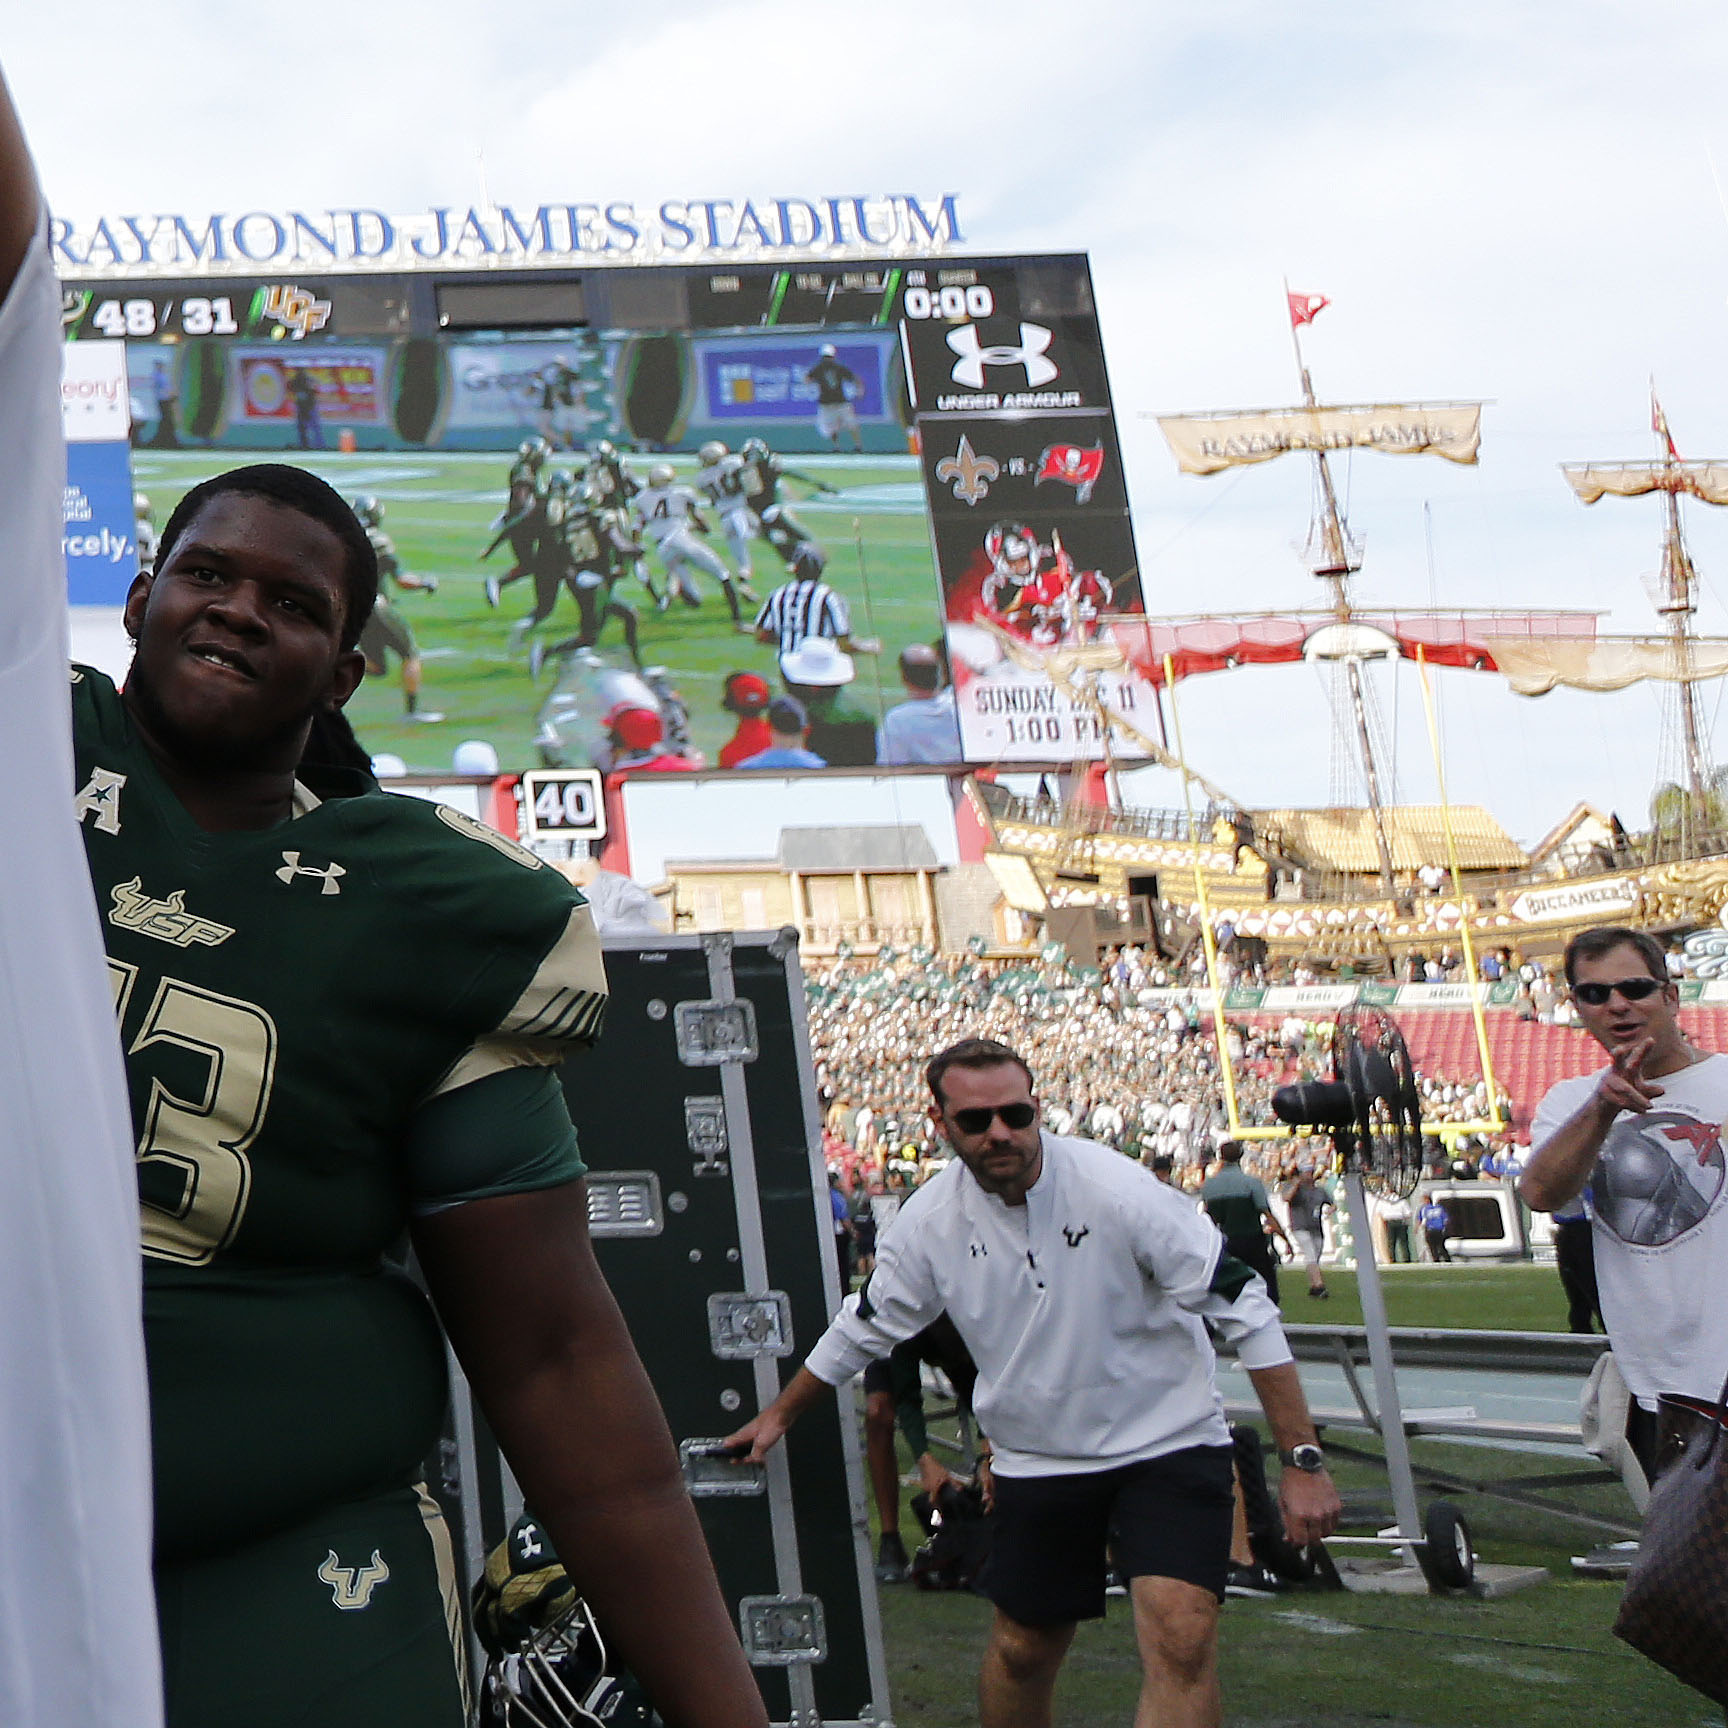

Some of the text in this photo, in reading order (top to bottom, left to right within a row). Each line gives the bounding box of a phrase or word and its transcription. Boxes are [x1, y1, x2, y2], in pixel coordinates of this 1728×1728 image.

[48, 191, 968, 265] RAYMOND JAMES STADIUM
[93, 298, 157, 337] 48
[181, 297, 240, 336] 31
[903, 285, 994, 320] 0:00
[936, 391, 1081, 411] UNDER ARMOUR
[1006, 716, 1061, 744] 1:00
[535, 782, 595, 826] 40
[107, 874, 237, 949] USF
